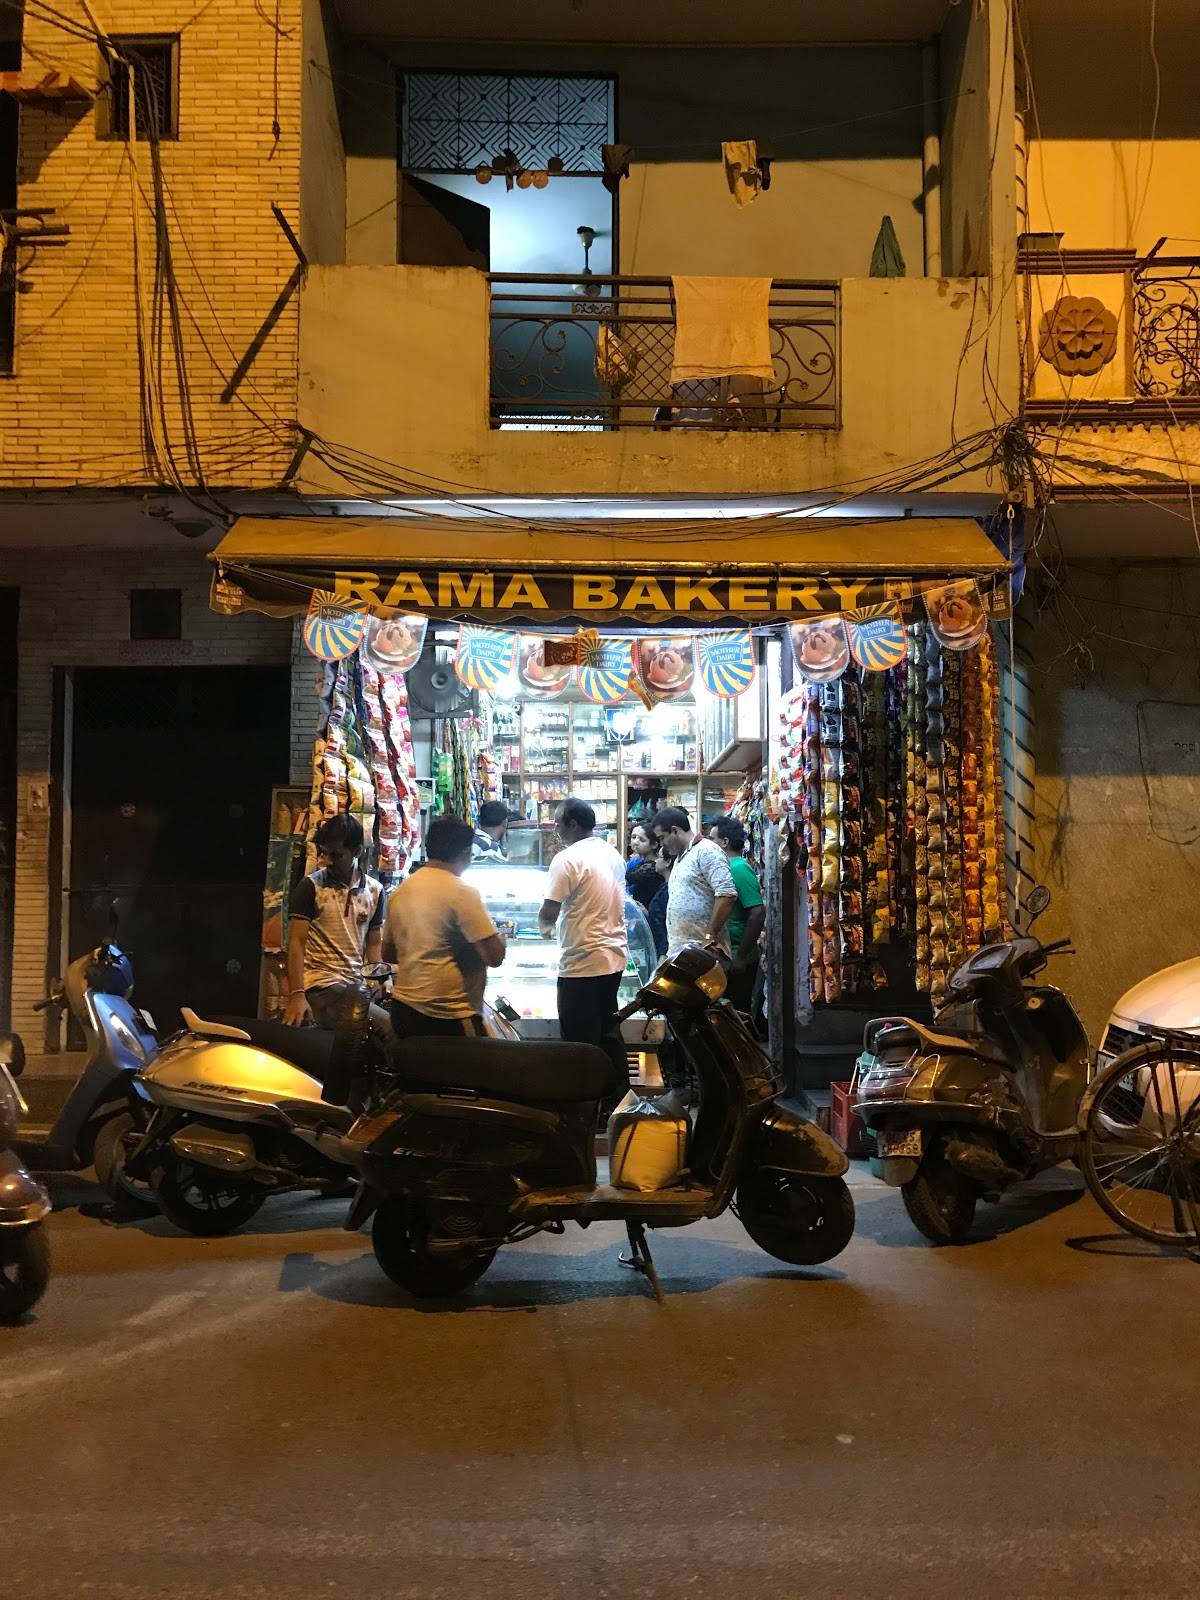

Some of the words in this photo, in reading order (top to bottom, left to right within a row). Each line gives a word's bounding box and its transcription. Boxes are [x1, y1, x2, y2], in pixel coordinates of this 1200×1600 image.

[334, 571, 549, 608] RAMA
[572, 574, 872, 611] BAKERY
[860, 619, 890, 631] MOTHER
[710, 647, 740, 655] MOTHER
[591, 653, 621, 661] MOTHER
